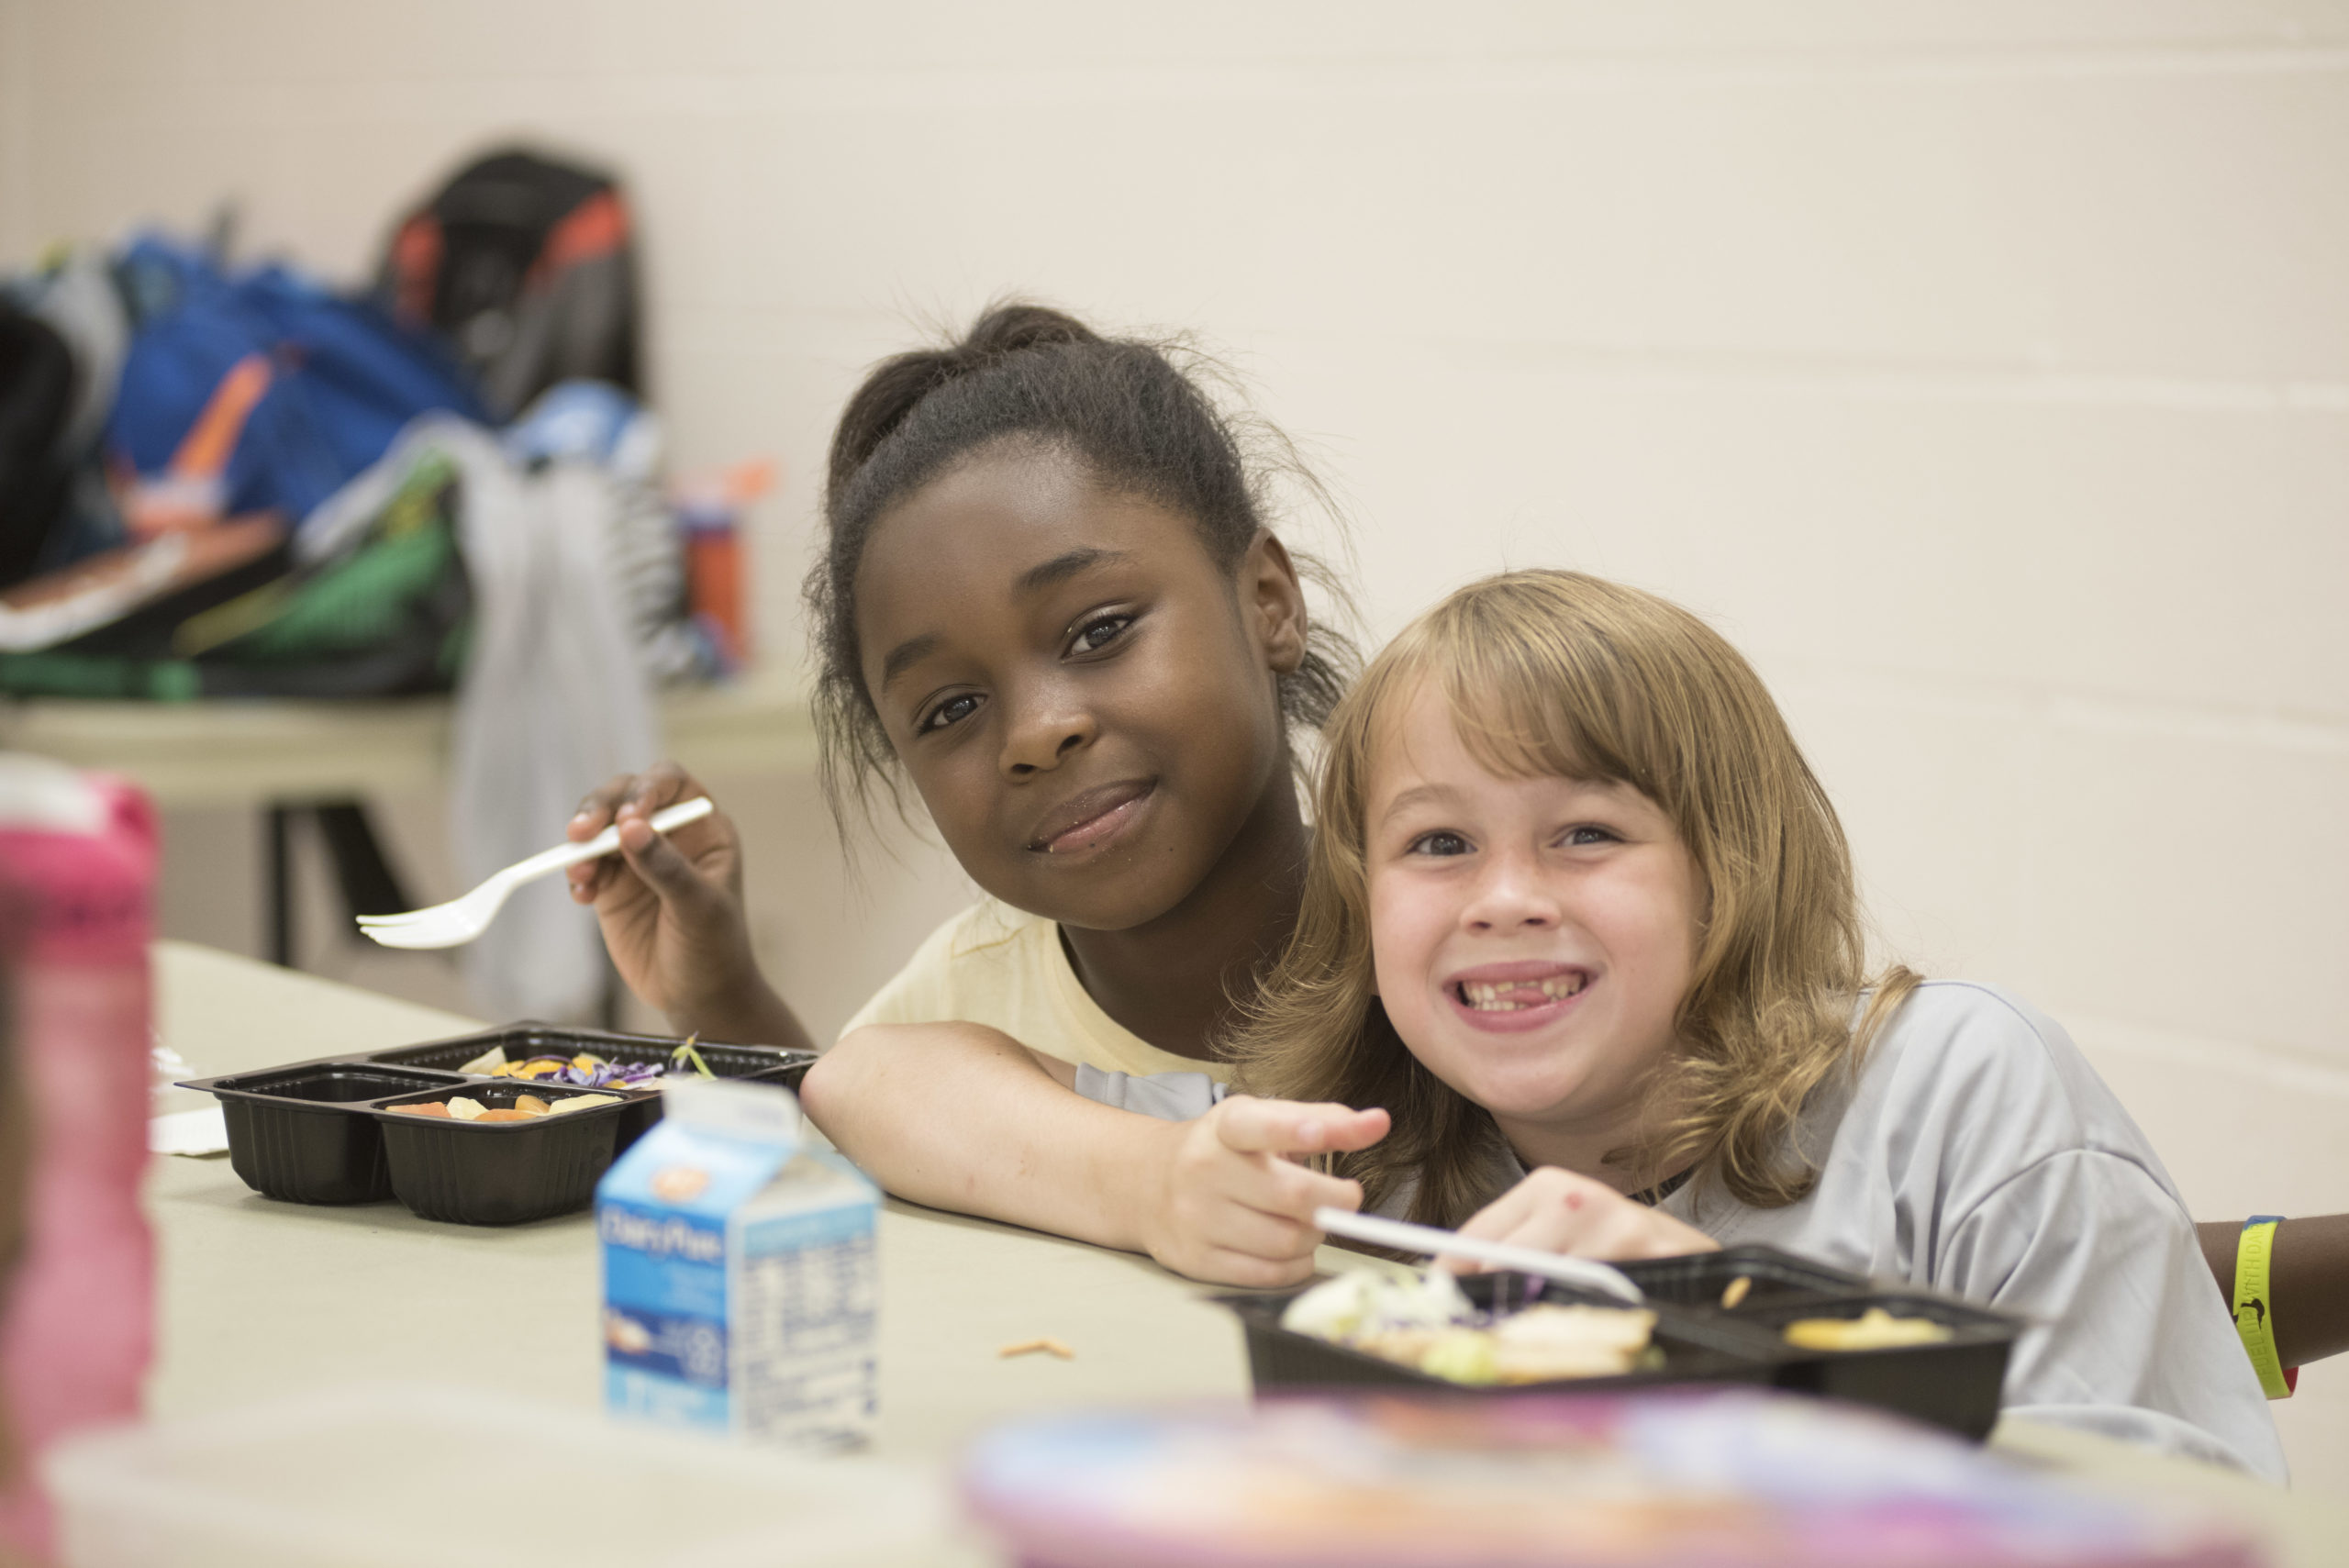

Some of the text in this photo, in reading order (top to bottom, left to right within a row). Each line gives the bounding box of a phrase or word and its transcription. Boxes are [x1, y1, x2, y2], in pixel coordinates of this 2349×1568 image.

[2243, 1259, 2262, 1301] WITH
[2243, 1307, 2261, 1335] UP
[2249, 1337, 2270, 1376] FUEL
